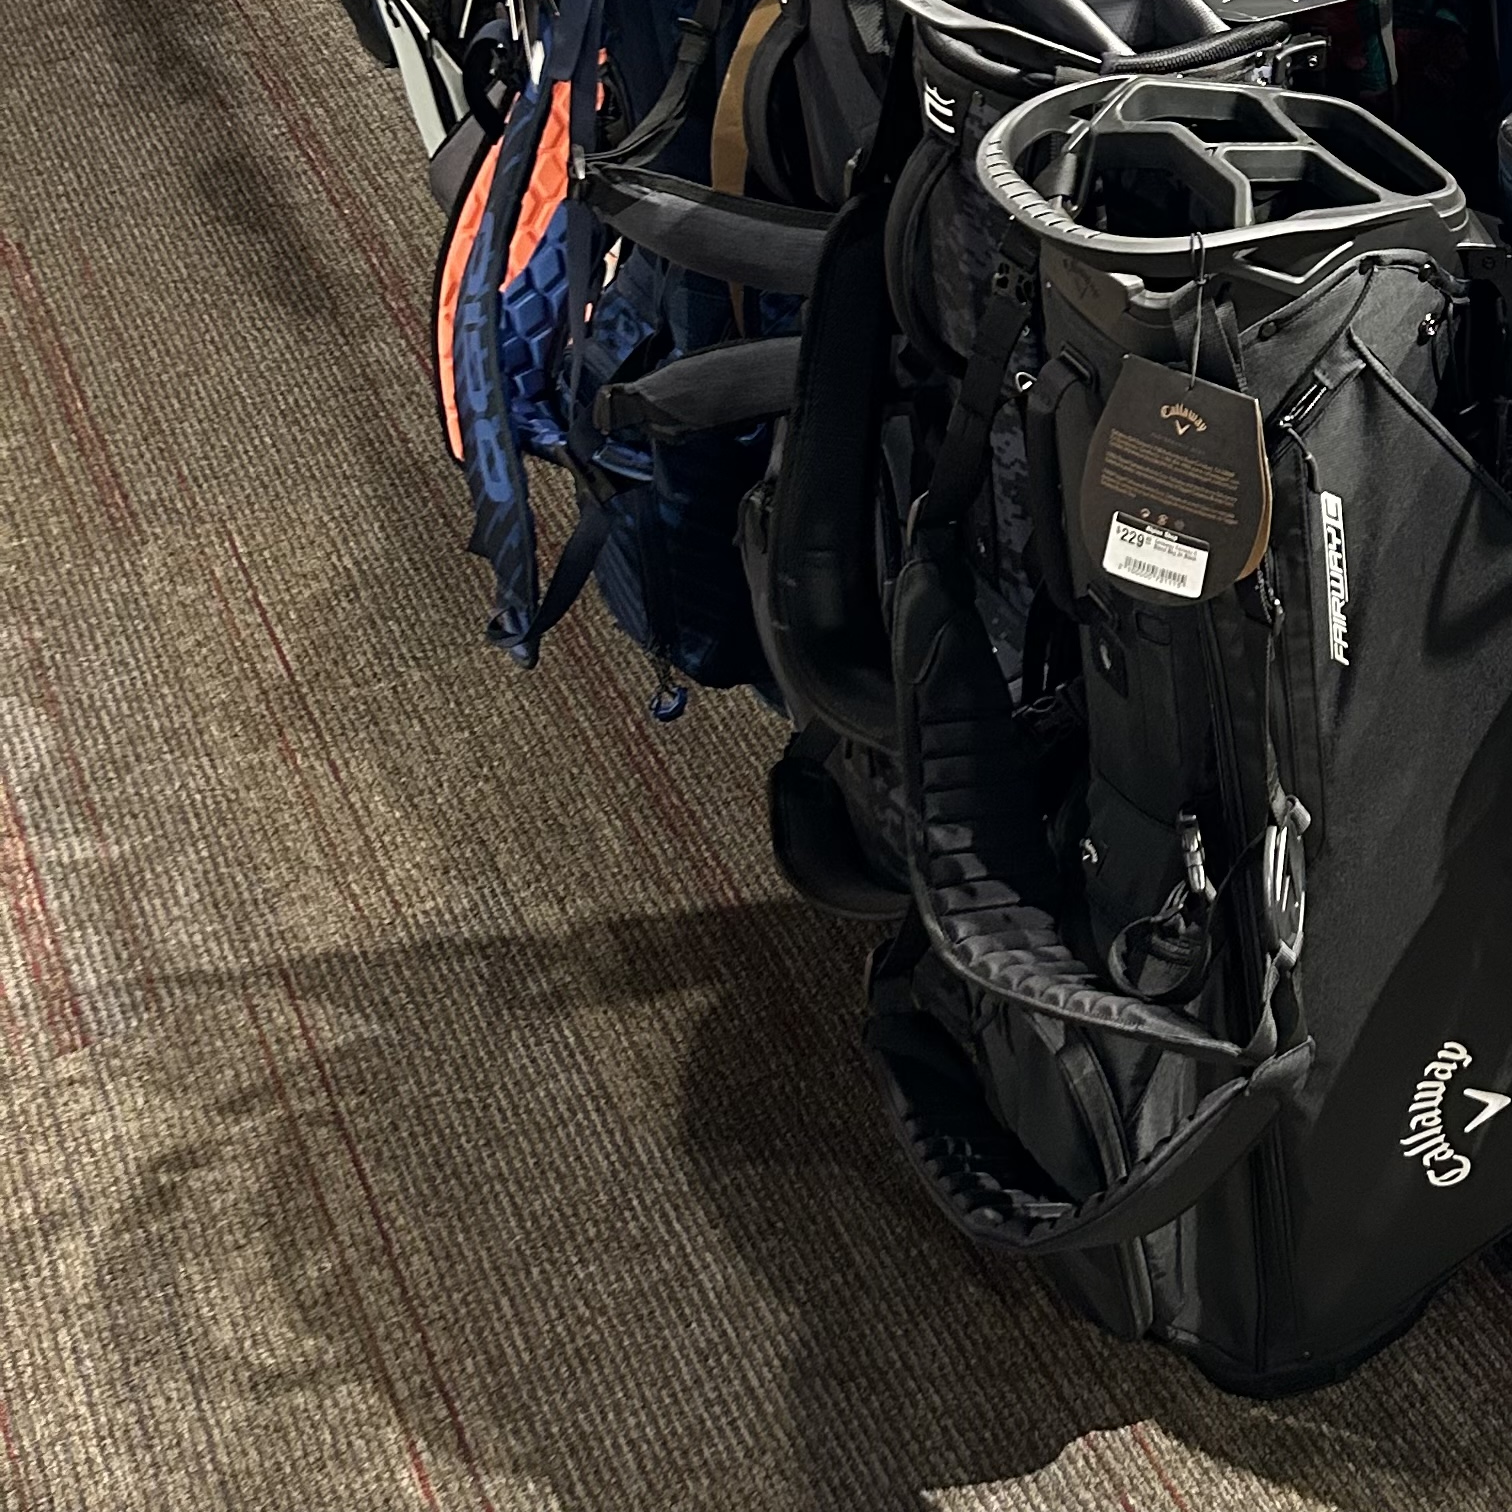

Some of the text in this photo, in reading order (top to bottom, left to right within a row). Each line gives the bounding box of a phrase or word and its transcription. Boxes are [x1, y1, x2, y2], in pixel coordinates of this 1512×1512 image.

[1160, 403, 1208, 433] Callaway
[1326, 526, 1349, 666] FAIRWAY
[1400, 1041, 1473, 1187] Callaway
